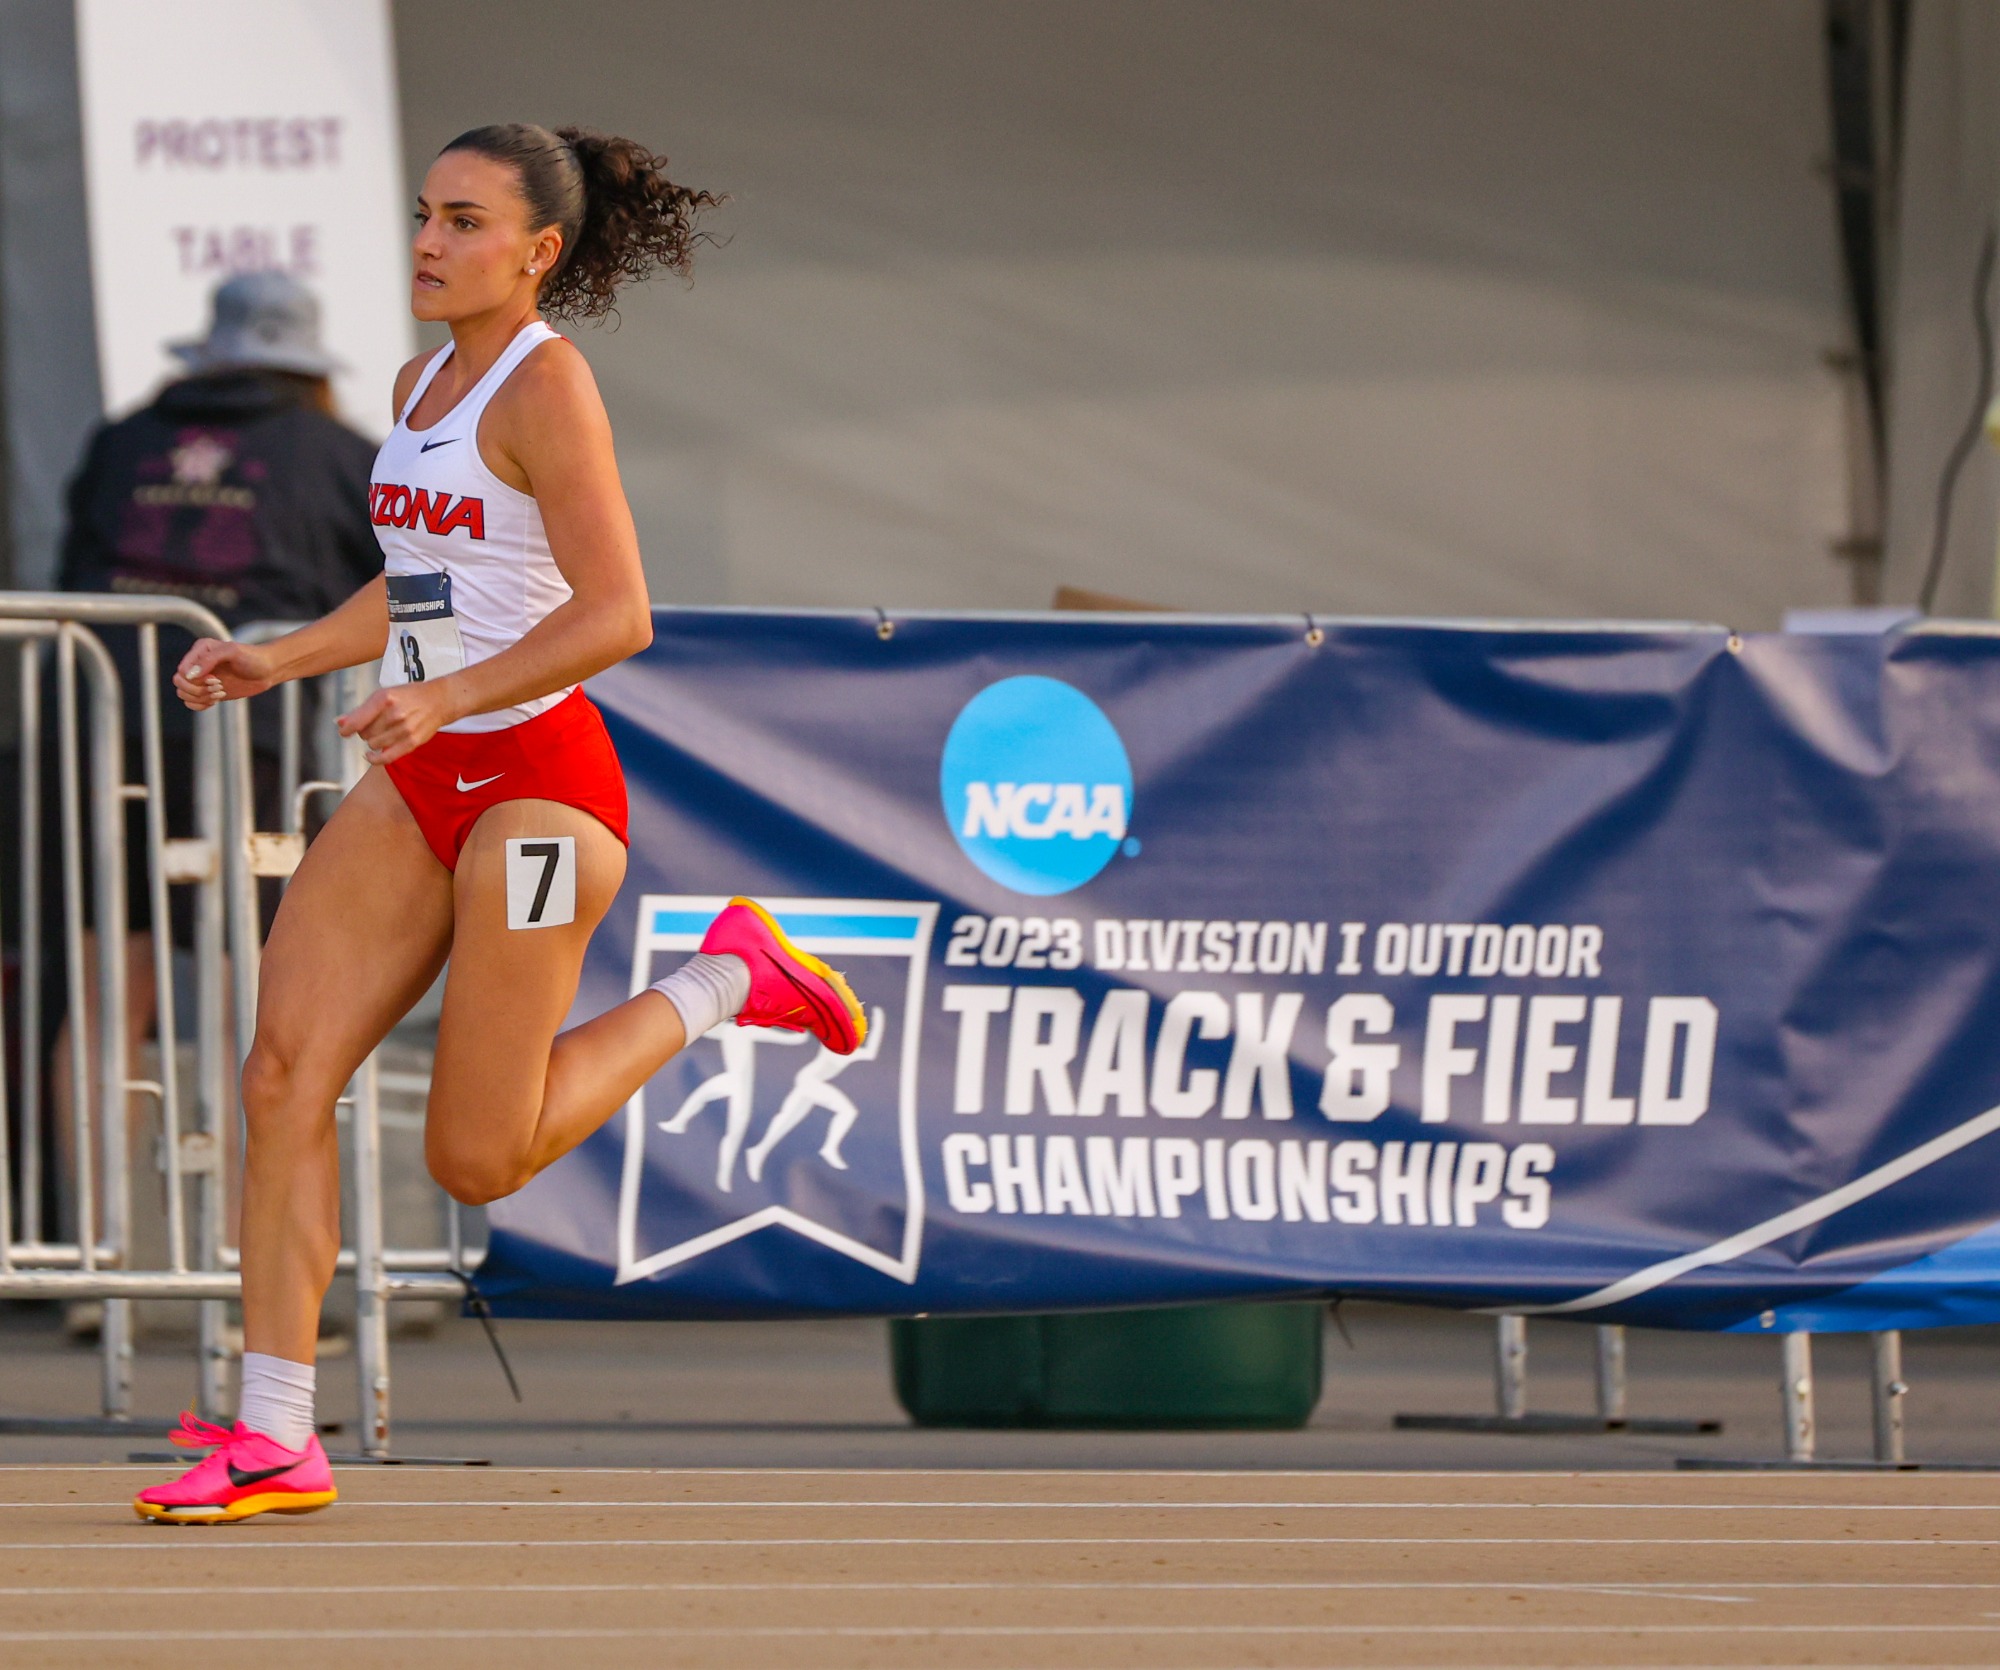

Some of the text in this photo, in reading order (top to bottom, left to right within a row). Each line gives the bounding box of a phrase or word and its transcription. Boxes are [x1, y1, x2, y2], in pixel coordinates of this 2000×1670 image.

[136, 116, 342, 169] PROTEST
[172, 226, 323, 275] TABLE
[369, 483, 485, 540] IZONA
[962, 782, 1127, 840] NCAA
[521, 843, 560, 922] 7
[945, 915, 1603, 977] 2023 DIVISION I OUTDOOR
[942, 985, 1719, 1125] TRACK & FIELD
[942, 1133, 1556, 1229] CHAMPIONSHIPS
